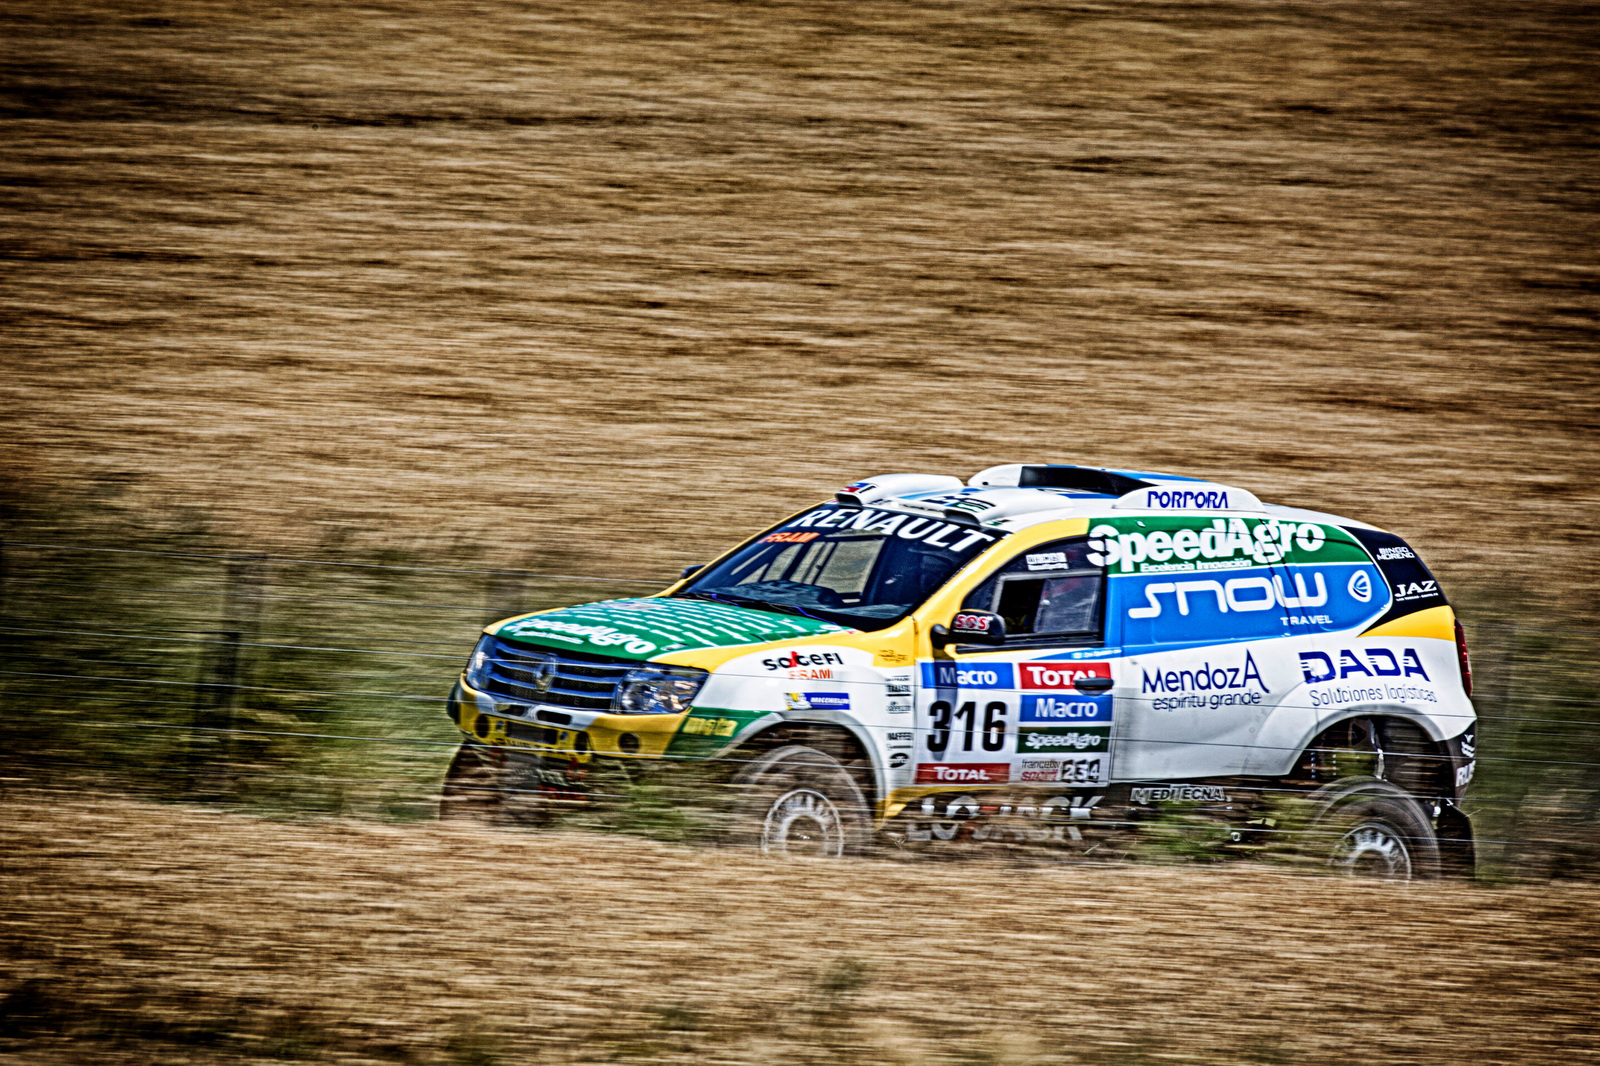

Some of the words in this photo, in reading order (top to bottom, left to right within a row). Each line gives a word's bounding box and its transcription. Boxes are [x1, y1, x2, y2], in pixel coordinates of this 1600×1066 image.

[1147, 490, 1229, 509] PORPORA
[758, 532, 821, 544] FRAM
[789, 507, 996, 553] RENAULT
[1086, 517, 1327, 573] SpeedAgro
[1394, 580, 1437, 597] JAZ
[1280, 614, 1333, 626] TRAVEL
[1298, 648, 1432, 684] DADA
[940, 667, 998, 685] Macro
[1209, 690, 1262, 710] grande
[1310, 686, 1382, 707] Soluciones
[1035, 698, 1098, 718] Macro
[926, 701, 1008, 752] 316
[1025, 732, 1101, 749] SpeedAgro
[933, 767, 991, 780] TOTAL
